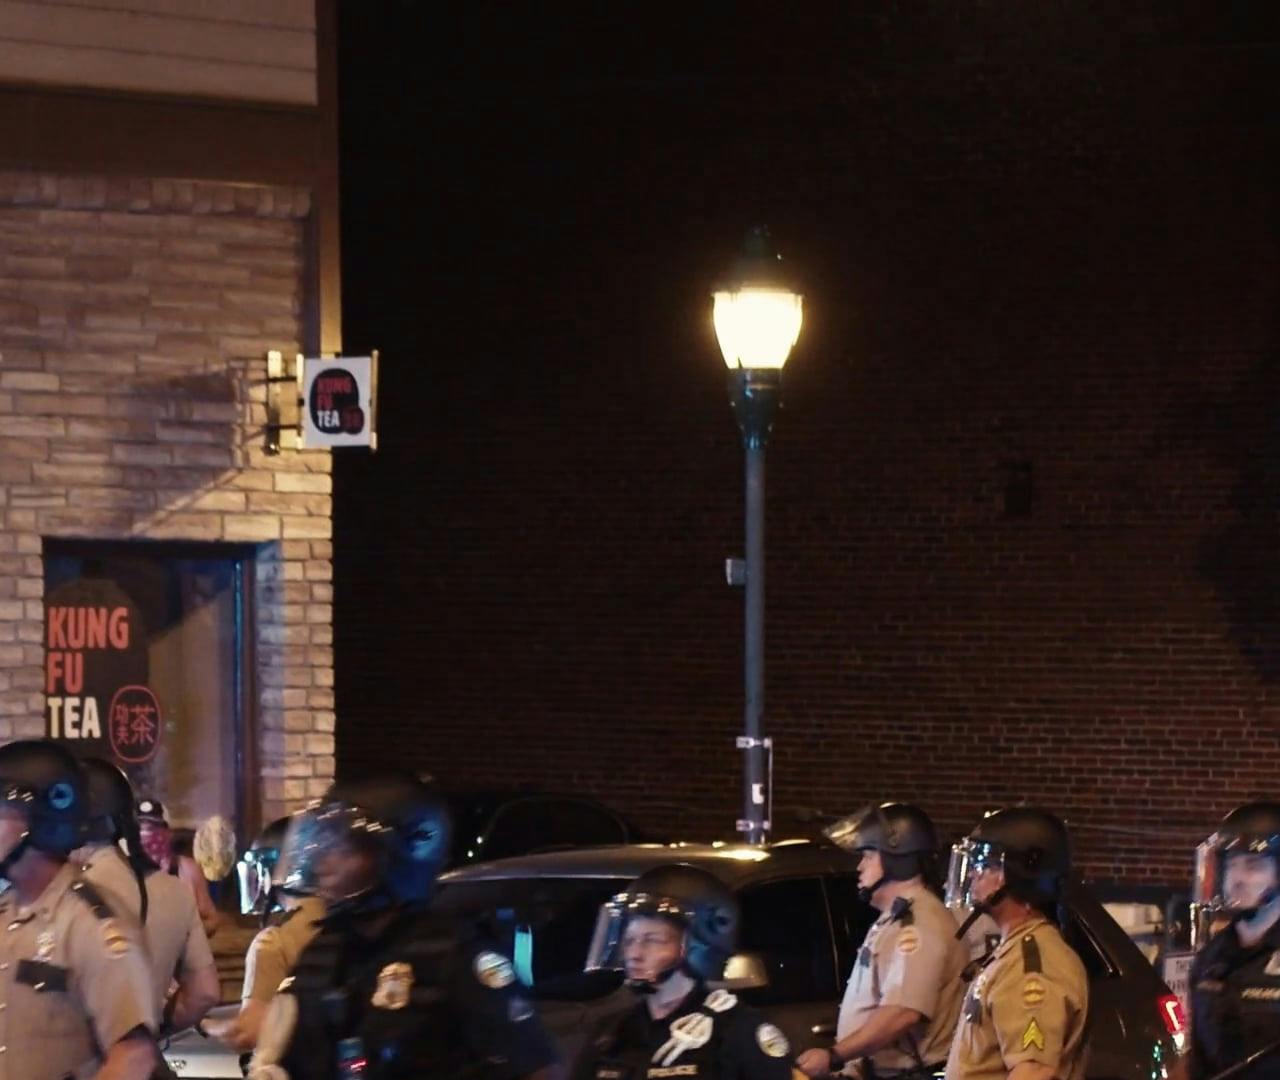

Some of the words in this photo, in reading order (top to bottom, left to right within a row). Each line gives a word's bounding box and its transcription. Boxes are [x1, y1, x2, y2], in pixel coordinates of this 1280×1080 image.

[317, 410, 340, 428] TEA
[47, 607, 129, 649] KUNG
[47, 652, 84, 694] FU
[47, 697, 101, 739] TEA
